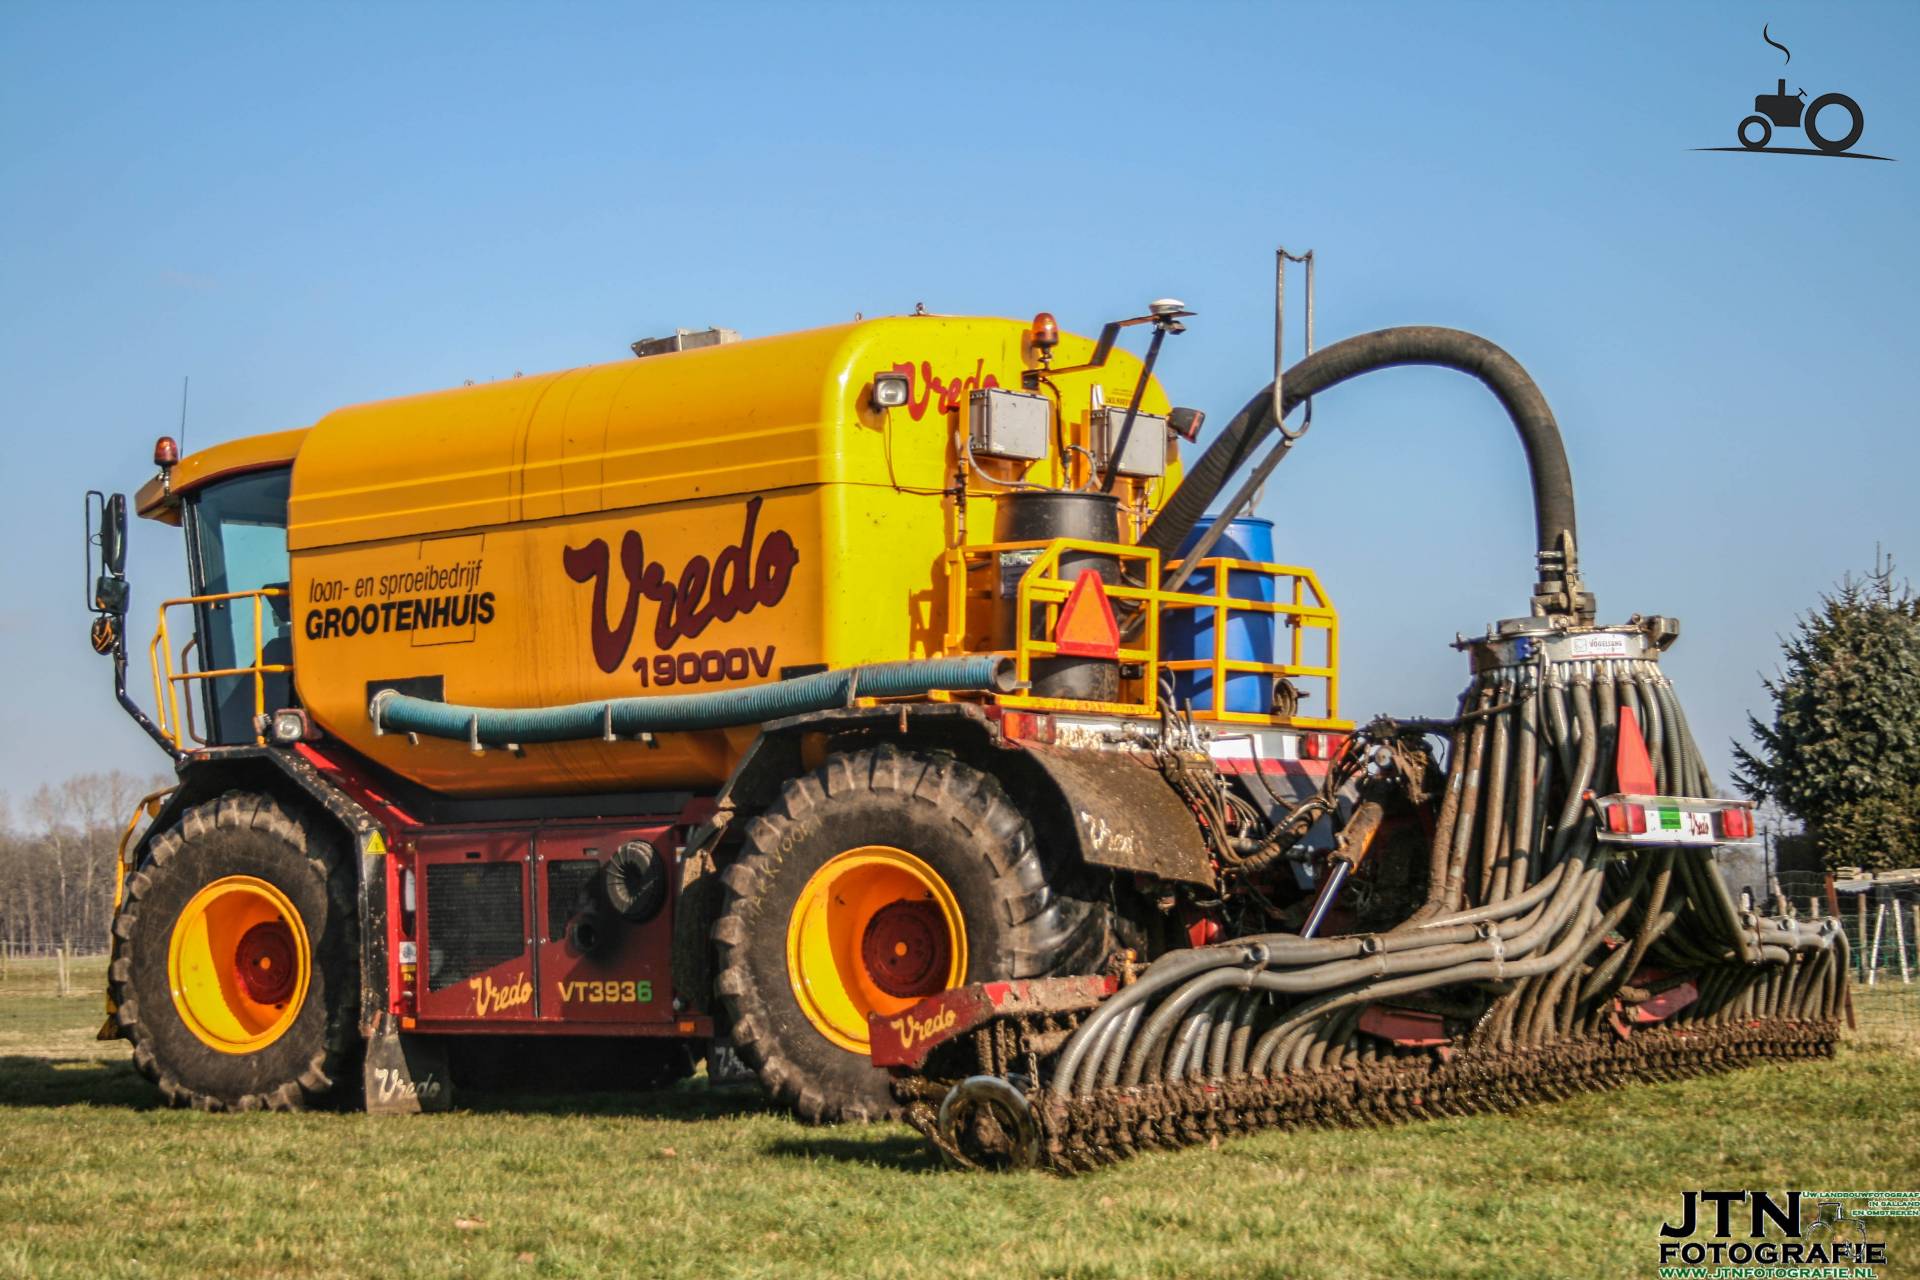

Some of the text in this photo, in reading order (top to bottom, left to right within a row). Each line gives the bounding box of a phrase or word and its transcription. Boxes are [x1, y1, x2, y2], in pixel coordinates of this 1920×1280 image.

[309, 559, 483, 603] loon- en sproeibedrijf
[563, 497, 799, 674] Vredo
[305, 591, 496, 640] GROOTENHUIS
[633, 646, 776, 688] 19000V
[470, 972, 532, 1016] Vredo
[558, 980, 653, 1003] VT3936
[890, 1004, 957, 1048] Vredo
[375, 1068, 441, 1101] Vredo
